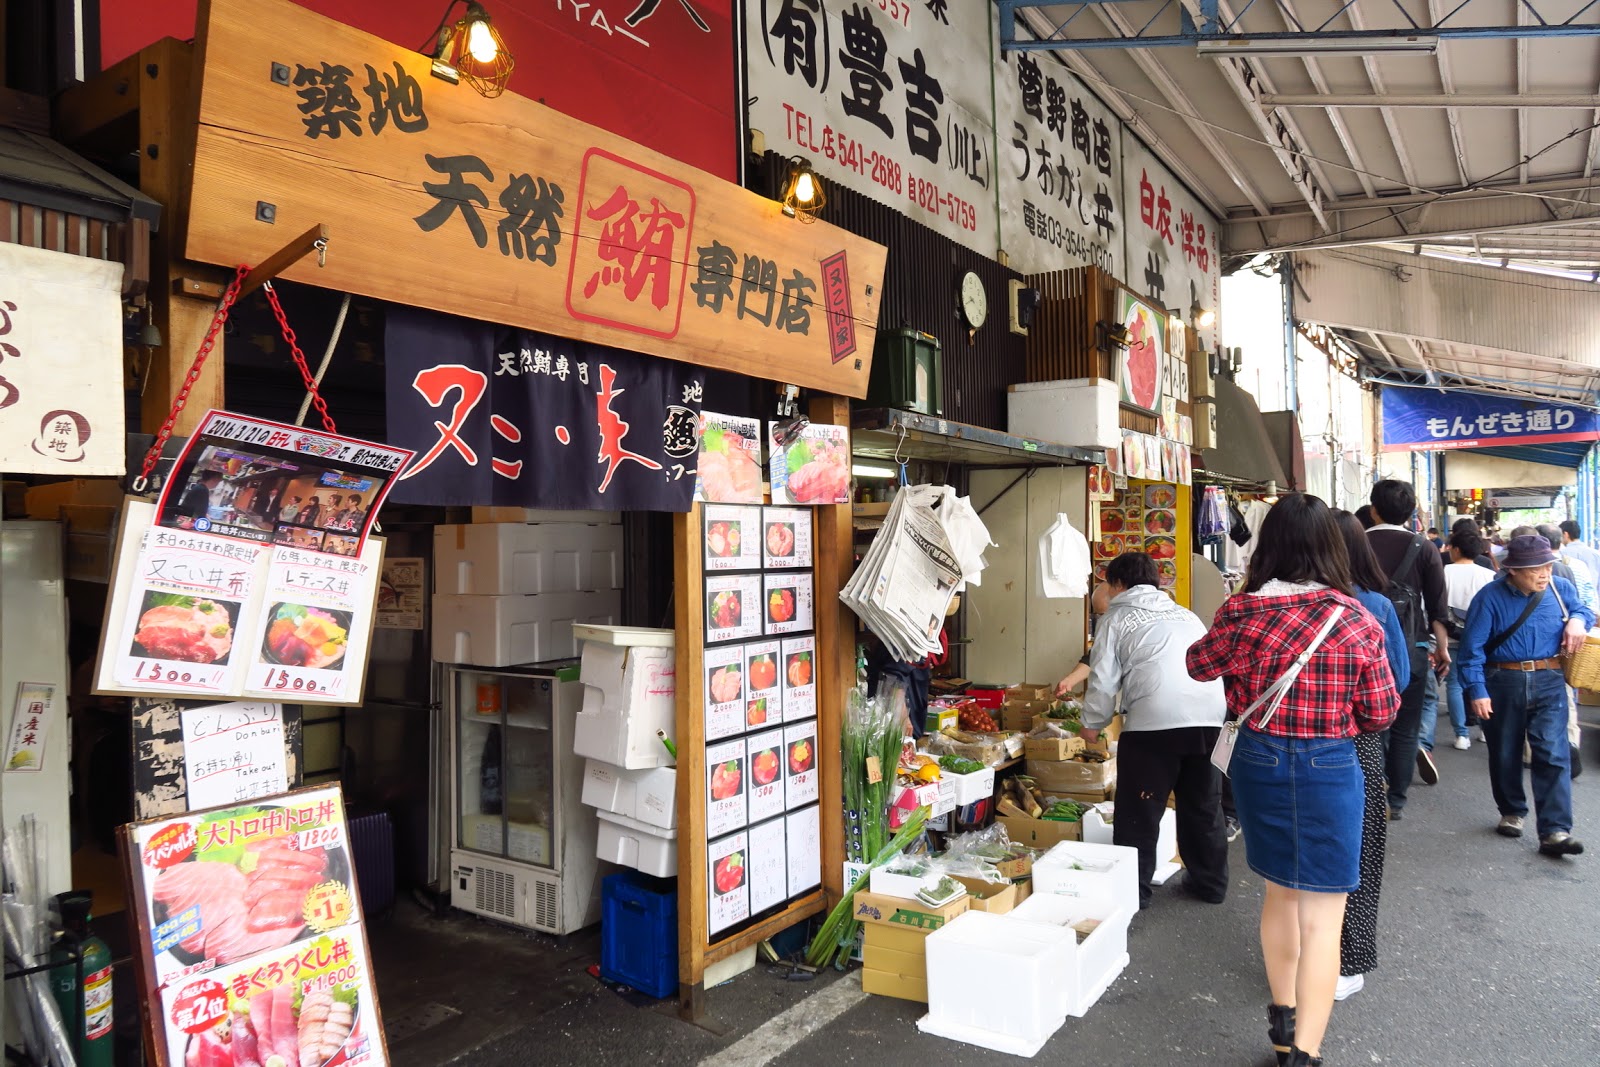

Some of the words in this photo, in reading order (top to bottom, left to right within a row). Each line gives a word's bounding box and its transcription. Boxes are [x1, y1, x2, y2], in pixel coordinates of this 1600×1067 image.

[294, 61, 428, 139] 築地
[48, 421, 72, 453] 築地
[1427, 409, 1574, 437] もんぜき通り
[22, 701, 44, 746] 国産米
[193, 751, 253, 777] お持ち帰り
[202, 800, 336, 852] 大トロ中トロ丼
[231, 938, 349, 999] まぐろづくし丼
[176, 996, 227, 1031] 第2位
